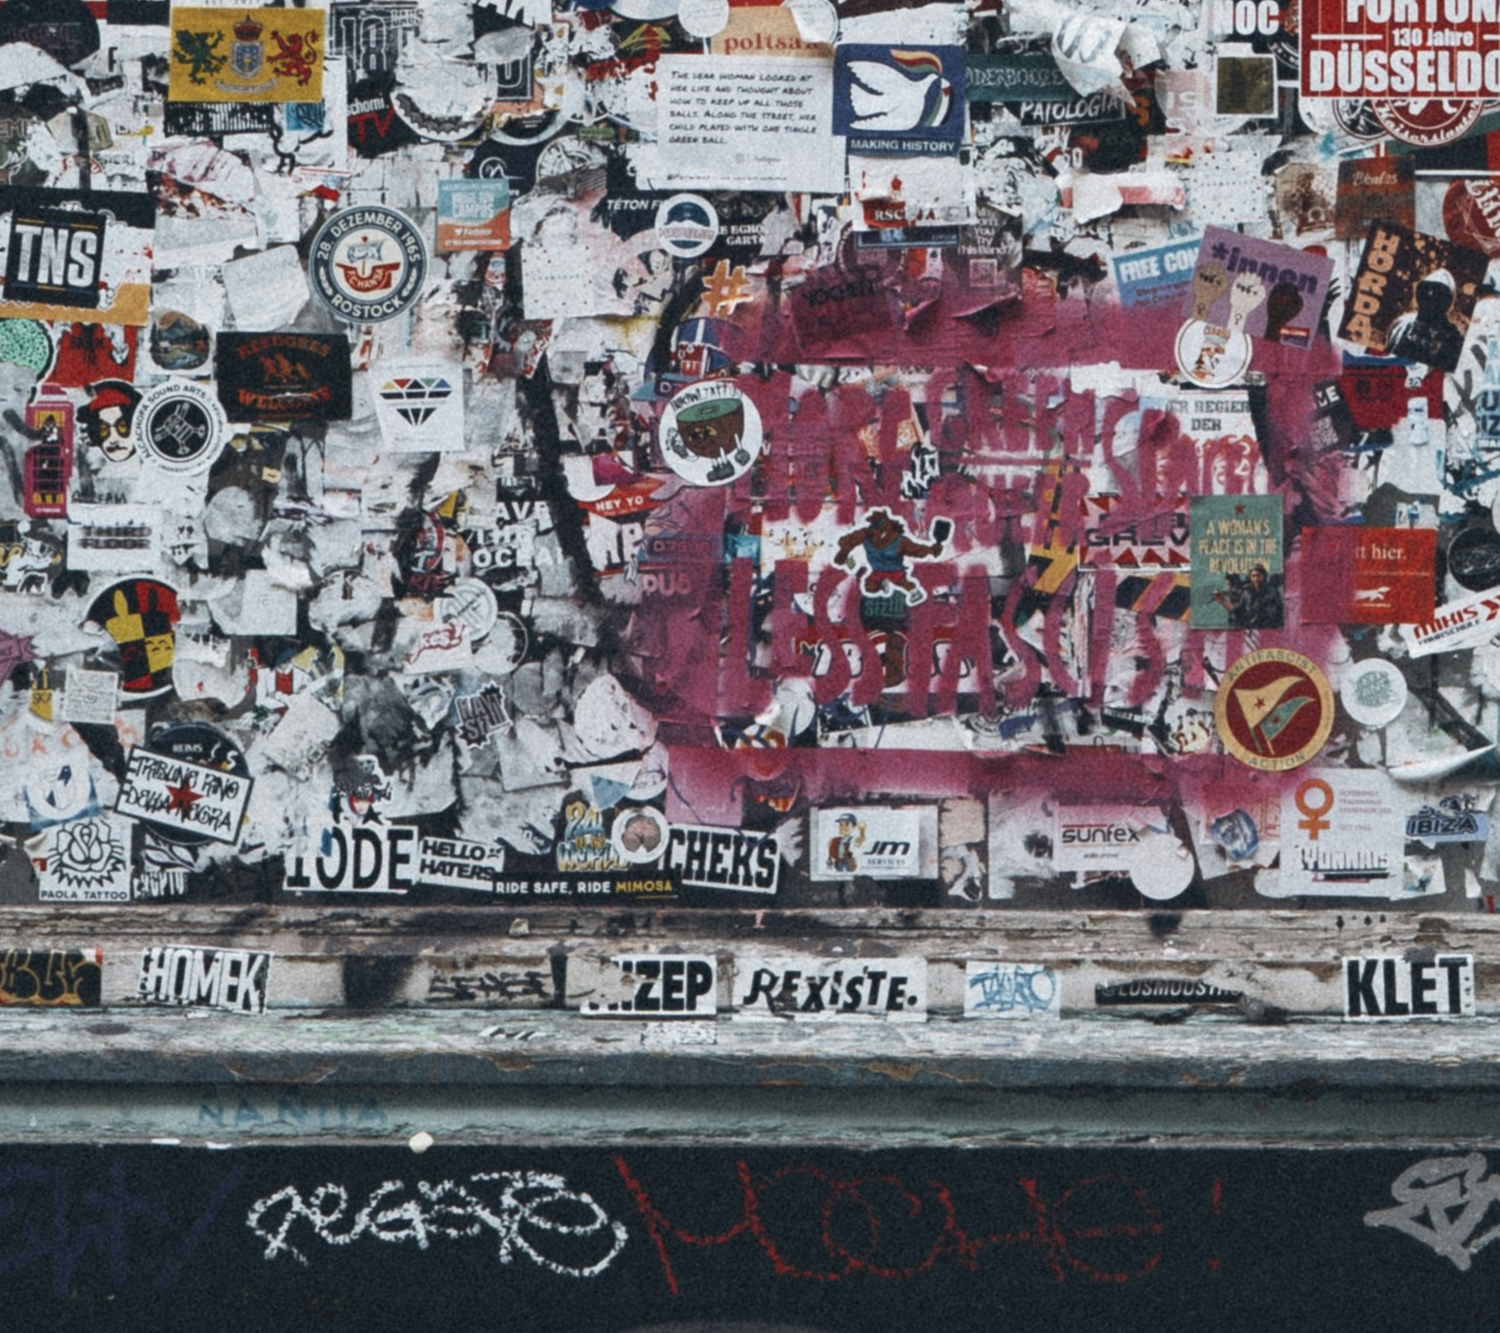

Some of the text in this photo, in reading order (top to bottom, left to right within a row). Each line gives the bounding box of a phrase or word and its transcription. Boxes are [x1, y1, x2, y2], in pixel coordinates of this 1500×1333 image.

[1391, 28, 1474, 47] 130 Jahre
[718, 71, 756, 83] WOMAN
[759, 73, 797, 83] LOOKED
[851, 138, 955, 154] MAKING HISTORY
[332, 210, 404, 239] DEZEMBER
[15, 225, 99, 287] TNS
[331, 293, 406, 319] ROSTOCK
[422, 840, 485, 860] HELLO
[670, 828, 777, 889] CHEKS
[419, 859, 497, 879] HATERS
[41, 890, 128, 900] PAOLA TATTOO
[532, 879, 673, 897] SAFE, RIDE MIMOSA
[145, 949, 267, 1010] HOMEK
